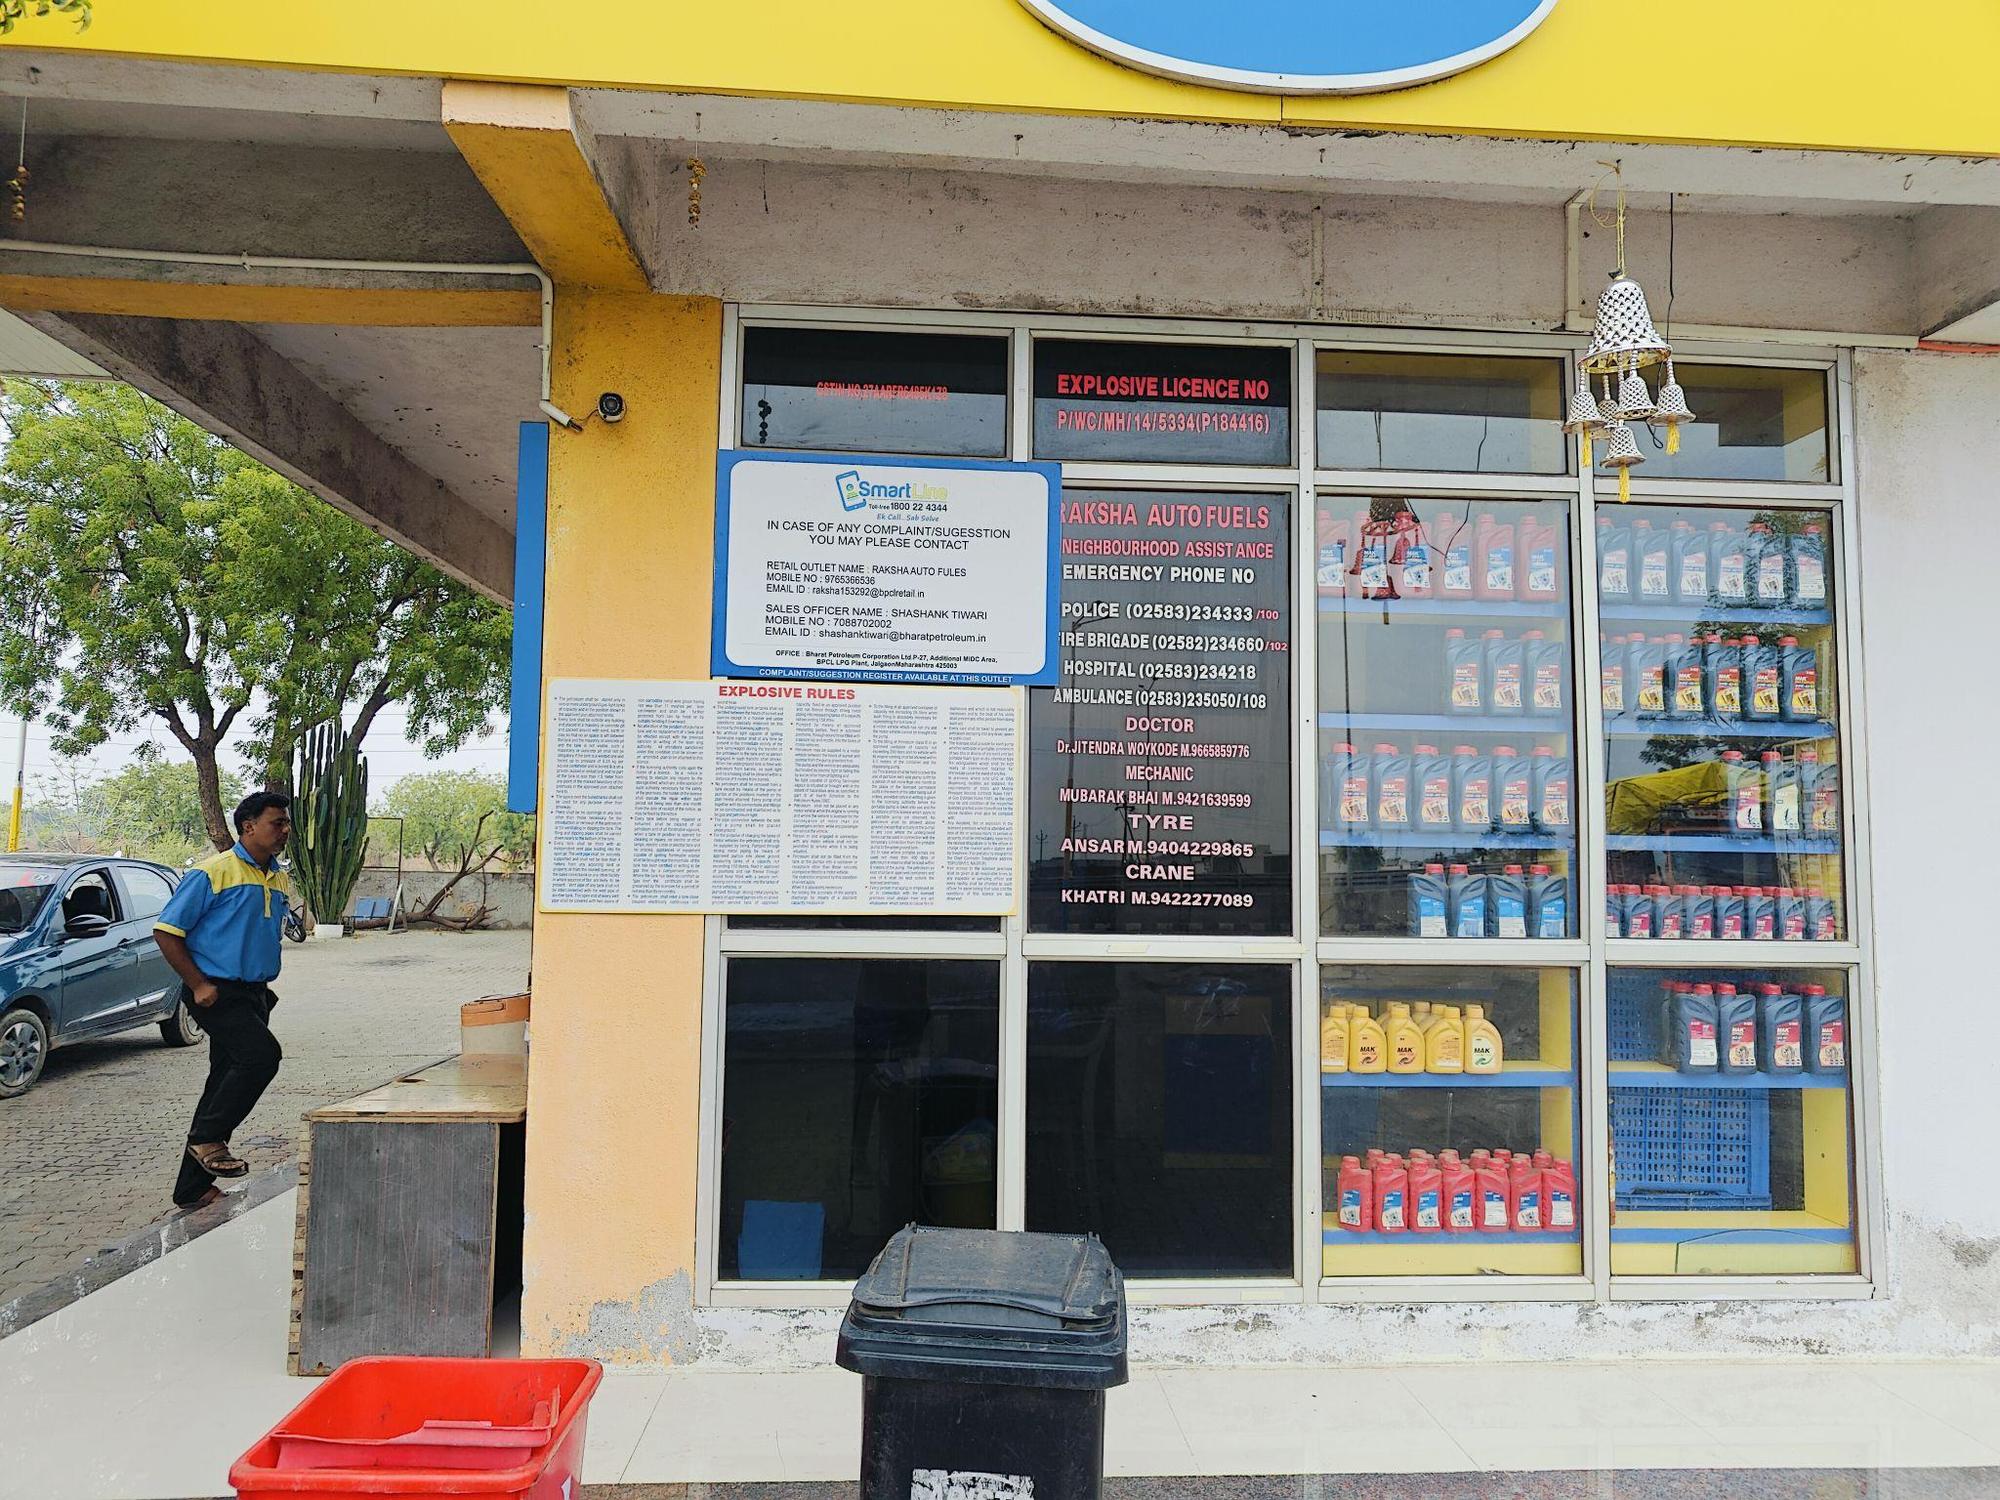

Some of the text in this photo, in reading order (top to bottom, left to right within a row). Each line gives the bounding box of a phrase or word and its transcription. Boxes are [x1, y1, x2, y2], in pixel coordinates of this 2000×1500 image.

[1056, 373, 1269, 400] EXPLOSIVE LICENCE NO
[1056, 408, 1271, 435] P/WC/MH/14/5334(P184416)
[890, 502, 911, 511] 1800
[912, 502, 923, 511] 22
[925, 503, 948, 512] 4344
[1147, 504, 1201, 527] AUTO
[1206, 505, 1270, 529] FUELS
[767, 520, 1011, 540] IN CASE OF ANY COMPLAINT/SUGESSTION
[809, 534, 969, 551] YOU MAY PLEASE CONTACT
[1061, 538, 1180, 557] NEIGHBOURHOOD
[766, 560, 798, 571] RETAIL
[800, 562, 837, 573] OUTLET
[838, 564, 865, 574] NAME
[937, 567, 967, 577] FULES
[1062, 564, 1256, 584] EMERGENCY PHONE NO
[766, 572, 802, 582] MOBILE
[803, 573, 818, 583] NO
[824, 574, 876, 585] 9765366536
[766, 583, 794, 593] EMAIL
[796, 584, 806, 594] ID
[765, 603, 800, 614] SALES
[803, 605, 850, 616] OFFICER
[852, 607, 883, 617] NAME
[891, 608, 949, 619] SHASHANK
[951, 610, 988, 620] TIWARI
[1061, 602, 1279, 621] POLICE (02583)234333 /100
[765, 615, 806, 626] MOBILE
[808, 617, 825, 627] NO
[833, 617, 892, 628] 7088702002
[765, 626, 797, 637] EMAIL
[800, 627, 811, 637] ID
[818, 628, 987, 643] shashanktiwari@bharatpetroleum.in
[1058, 631, 1288, 652] IRE BRIGADE (02582)234660 /102
[775, 649, 800, 657] OFFICE
[805, 650, 828, 658] Bharat
[828, 651, 861, 659] Petroleum
[861, 652, 900, 661] Corporation
[980, 656, 998, 664] Area,
[758, 668, 1014, 684] COMPLAINT/SUGGESTION REGISTER AVAILABLE AT THIS OUTLET
[1064, 659, 1257, 680] HOSPITAL (02583)234218
[719, 685, 856, 701] EXPLOSIVE RULES
[1053, 687, 1267, 709] AMBULANCE (02583)235050/108
[1125, 715, 1195, 733] DOCTOR
[1056, 739, 1250, 758] Dr.JITENDRA WOYKODE M.9665859776
[1125, 765, 1195, 782] MECHANIC
[1059, 788, 1252, 808] MUBARAK BHAI M.9421639599
[1127, 813, 1195, 830] TYRE
[1060, 838, 1255, 858] ANSAR M.9404229865
[1125, 863, 1195, 881] CRANE
[1061, 889, 1254, 908] KHATRI M.9422277089
